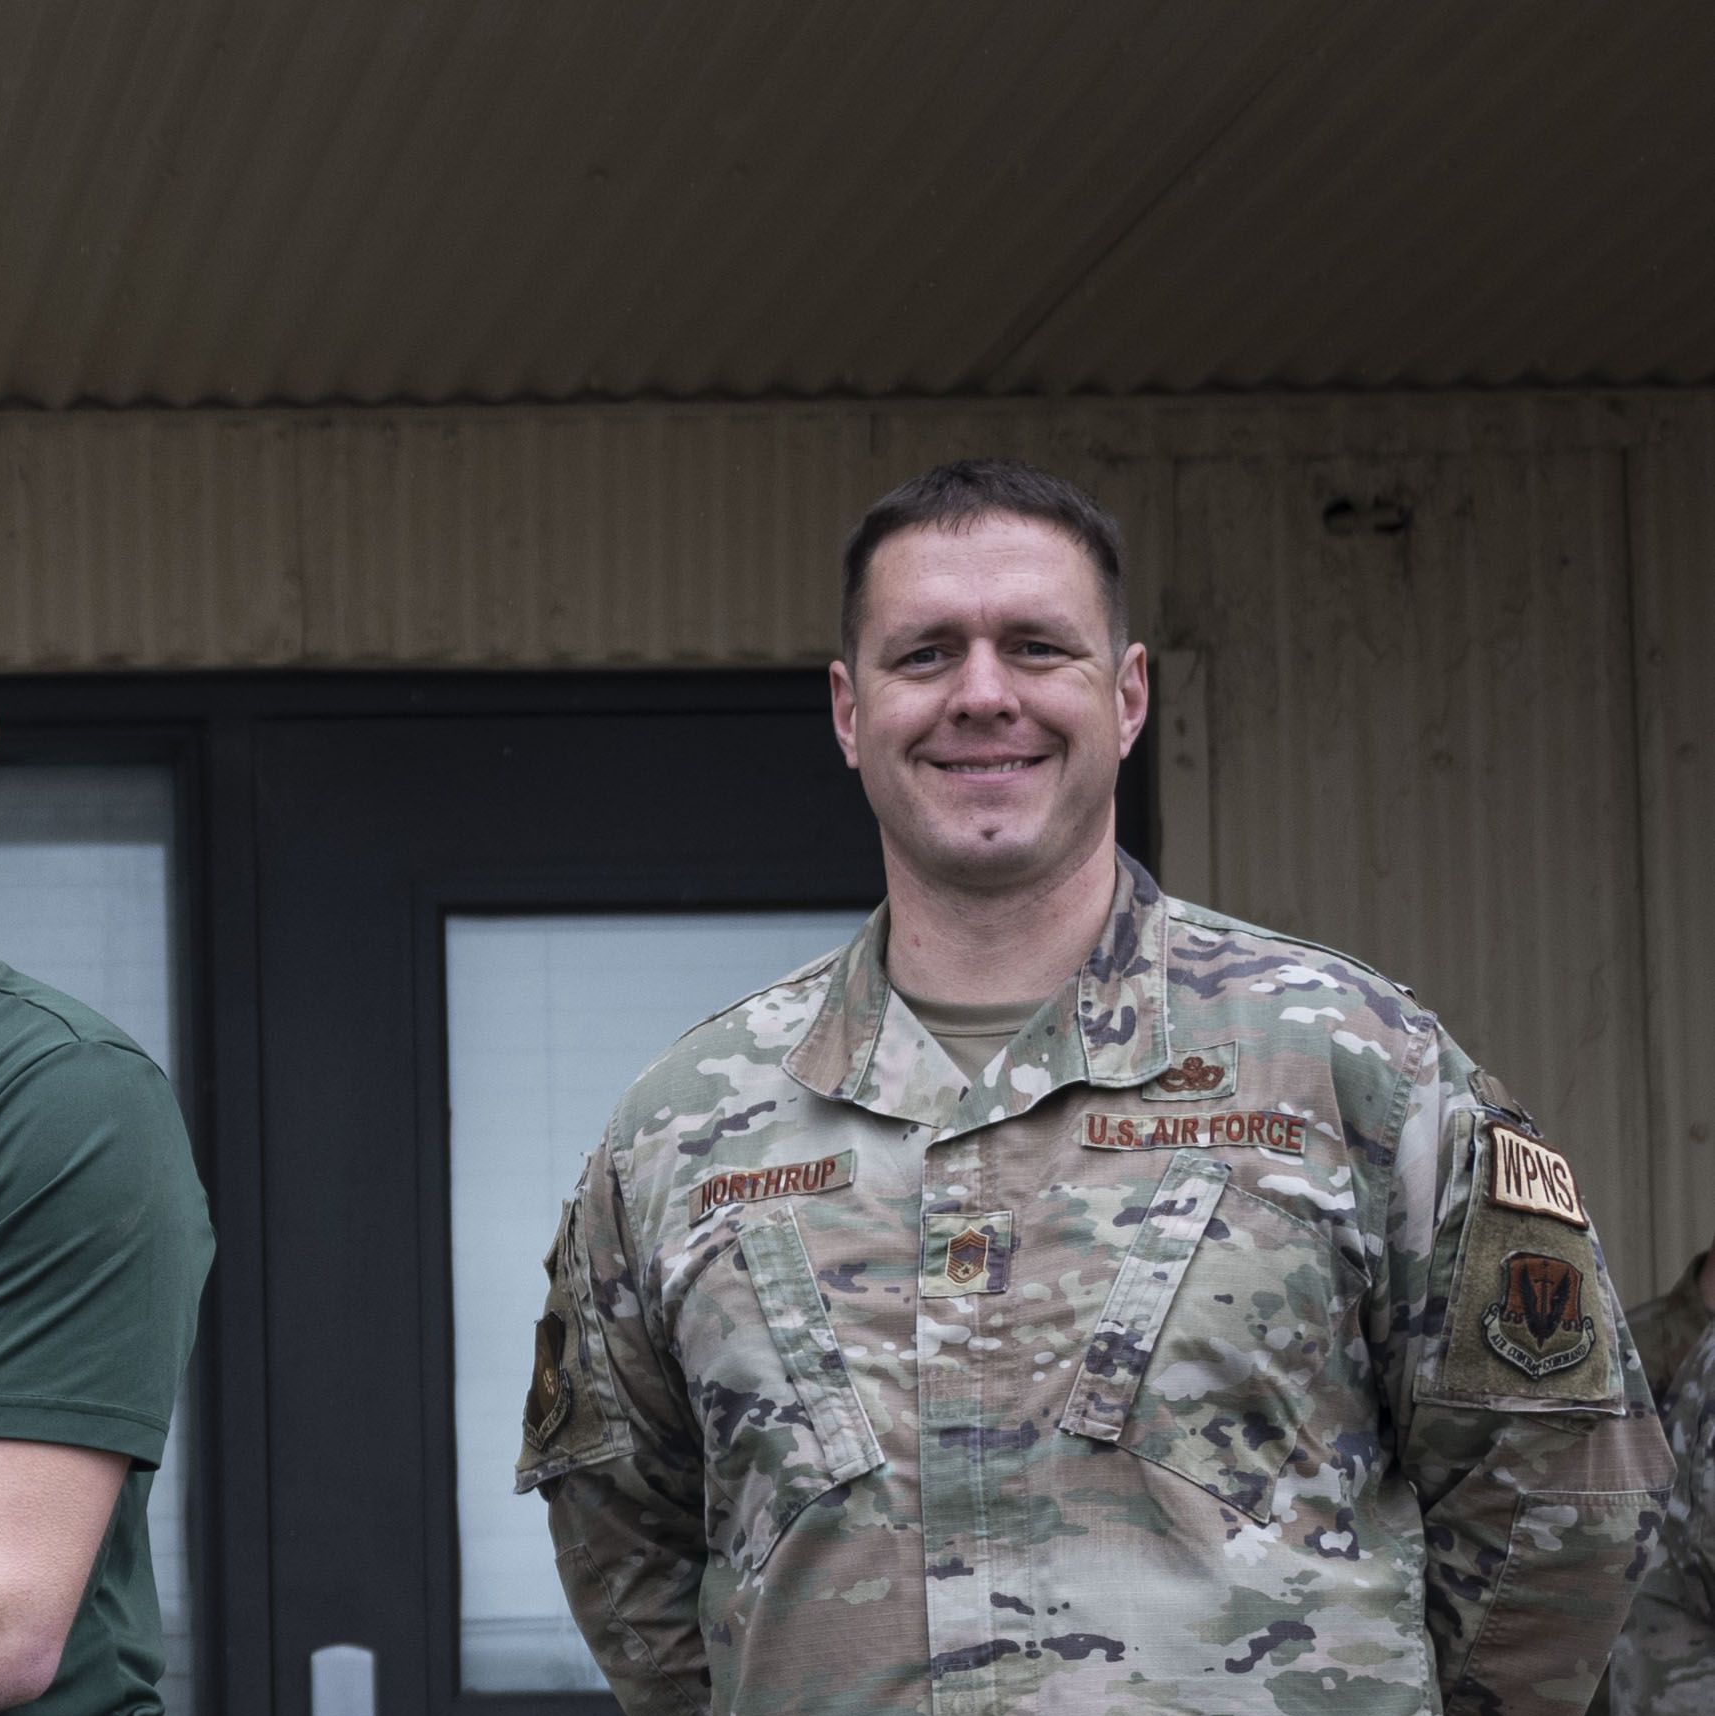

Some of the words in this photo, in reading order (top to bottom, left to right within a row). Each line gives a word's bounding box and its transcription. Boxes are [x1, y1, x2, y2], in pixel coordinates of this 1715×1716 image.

[1088, 1115, 1143, 1146] U.S.
[1150, 1117, 1200, 1145] AIR
[1209, 1113, 1306, 1150] FORCE
[701, 1157, 837, 1215] NORTHRUP
[1500, 1133, 1575, 1214] WPNS
